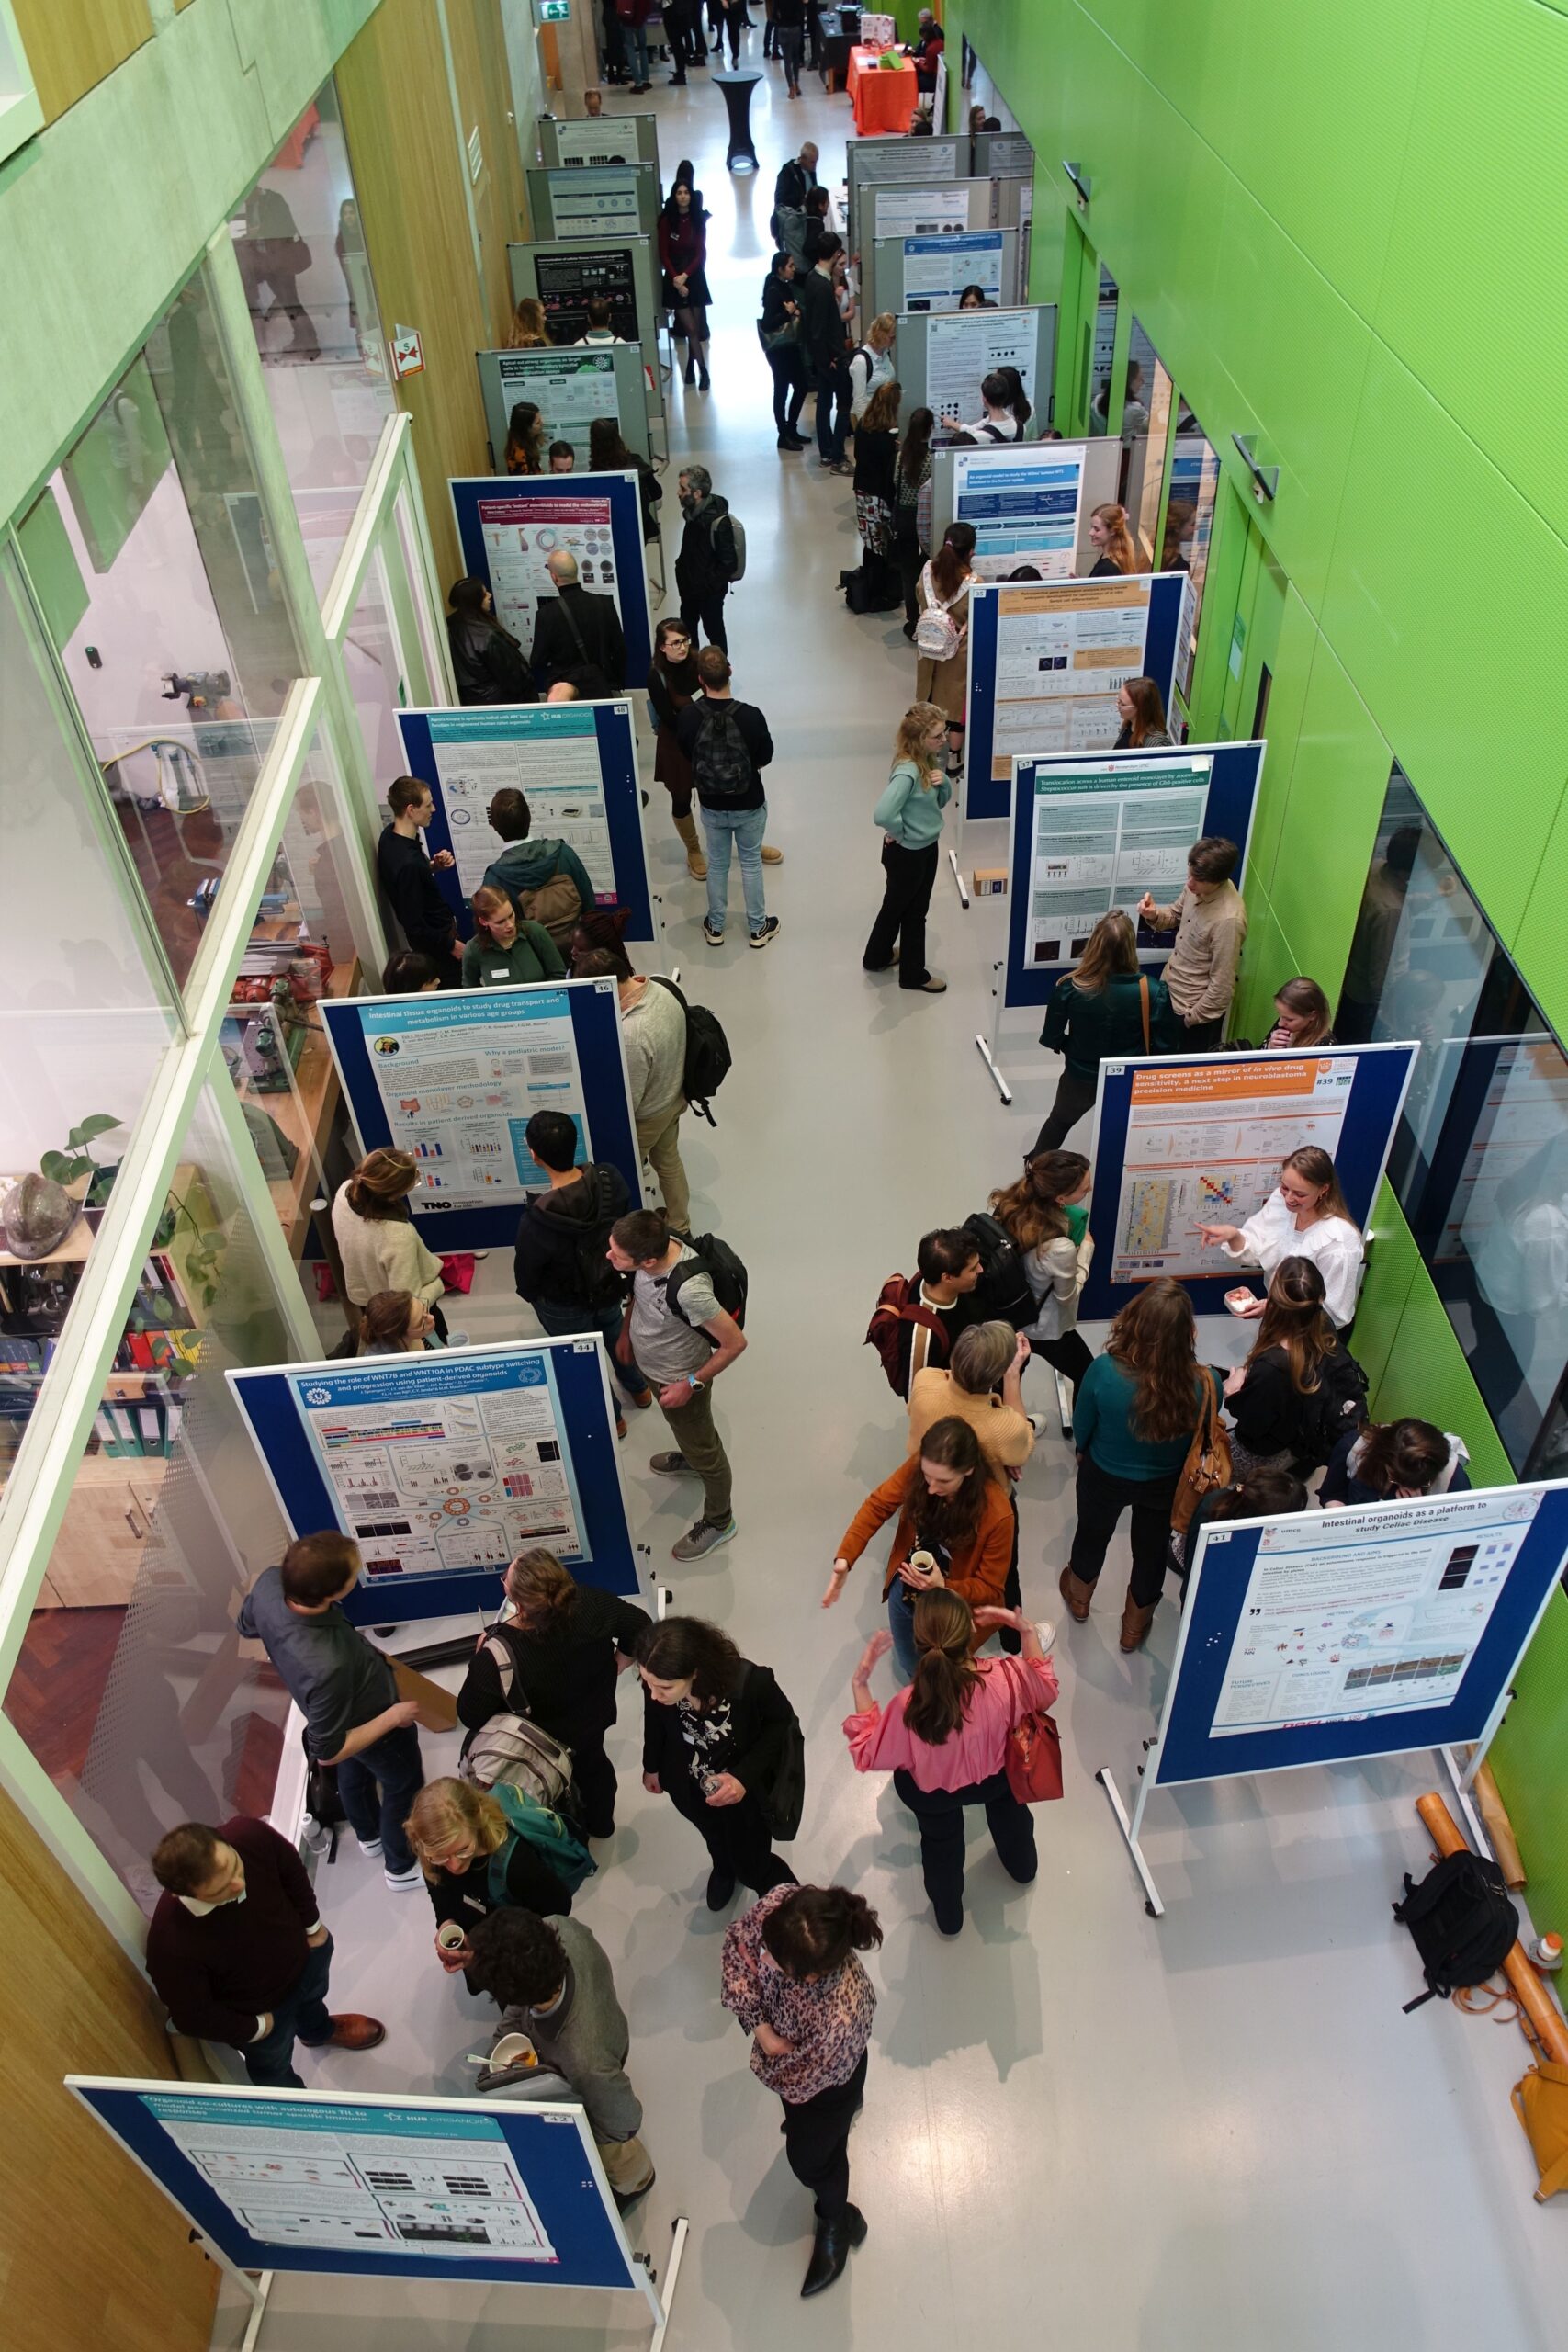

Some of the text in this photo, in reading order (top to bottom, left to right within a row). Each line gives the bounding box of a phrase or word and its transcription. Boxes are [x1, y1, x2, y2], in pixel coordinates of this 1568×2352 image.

[403, 342, 411, 352] S
[368, 1012, 402, 1020] Intestinal
[426, 1006, 462, 1016] organoids
[471, 1001, 493, 1011] study
[493, 1001, 511, 1009] drug
[511, 999, 545, 1007] transport
[407, 1015, 450, 1025] metabolism
[450, 1012, 458, 1020] in
[501, 1009, 525, 1017] groups
[484, 1049, 502, 1057] Why
[508, 1047, 539, 1056] pediatric
[539, 1045, 566, 1053] model?
[378, 1058, 420, 1069] Background
[1135, 1073, 1158, 1081] Drug
[1213, 1068, 1241, 1076] mirror
[1284, 1064, 1304, 1072] drug
[1243, 1071, 1307, 1080] neuroblastoma
[386, 1089, 418, 1099] Organoid
[418, 1085, 456, 1097] monolayer
[456, 1080, 502, 1091] methodology
[1175, 1084, 1213, 1092] medicine
[394, 1120, 422, 1128] Results
[427, 1117, 452, 1126] patient
[453, 1114, 479, 1123] derived
[479, 1111, 513, 1120] organoids
[421, 1201, 452, 1210] TNO
[300, 1380, 334, 1389] Studying
[370, 1372, 399, 1382] WNT7B
[413, 1367, 446, 1377] WNT10A
[454, 1364, 475, 1373] PDAC
[476, 1362, 505, 1371] subtype
[506, 1358, 541, 1368] switching
[353, 1381, 395, 1391] progression
[395, 1378, 416, 1386] using
[416, 1373, 472, 1385] patient-derived
[472, 1370, 508, 1379] organoids
[1322, 1517, 1366, 1528] Intestinal
[1367, 1510, 1414, 1524] organoids
[1436, 1503, 1476, 1516] platform
[1355, 1515, 1450, 1533] study Celiac Disease
[1311, 1554, 1352, 1562] BACKGROUND
[1230, 1680, 1271, 1689] PERSPECTIVES
[149, 2096, 196, 2105] Organoid
[197, 2100, 253, 2109] co-cultures
[280, 2107, 337, 2115] autologous
[157, 2108, 208, 2116] responses
[187, 2105, 251, 2114] personalized
